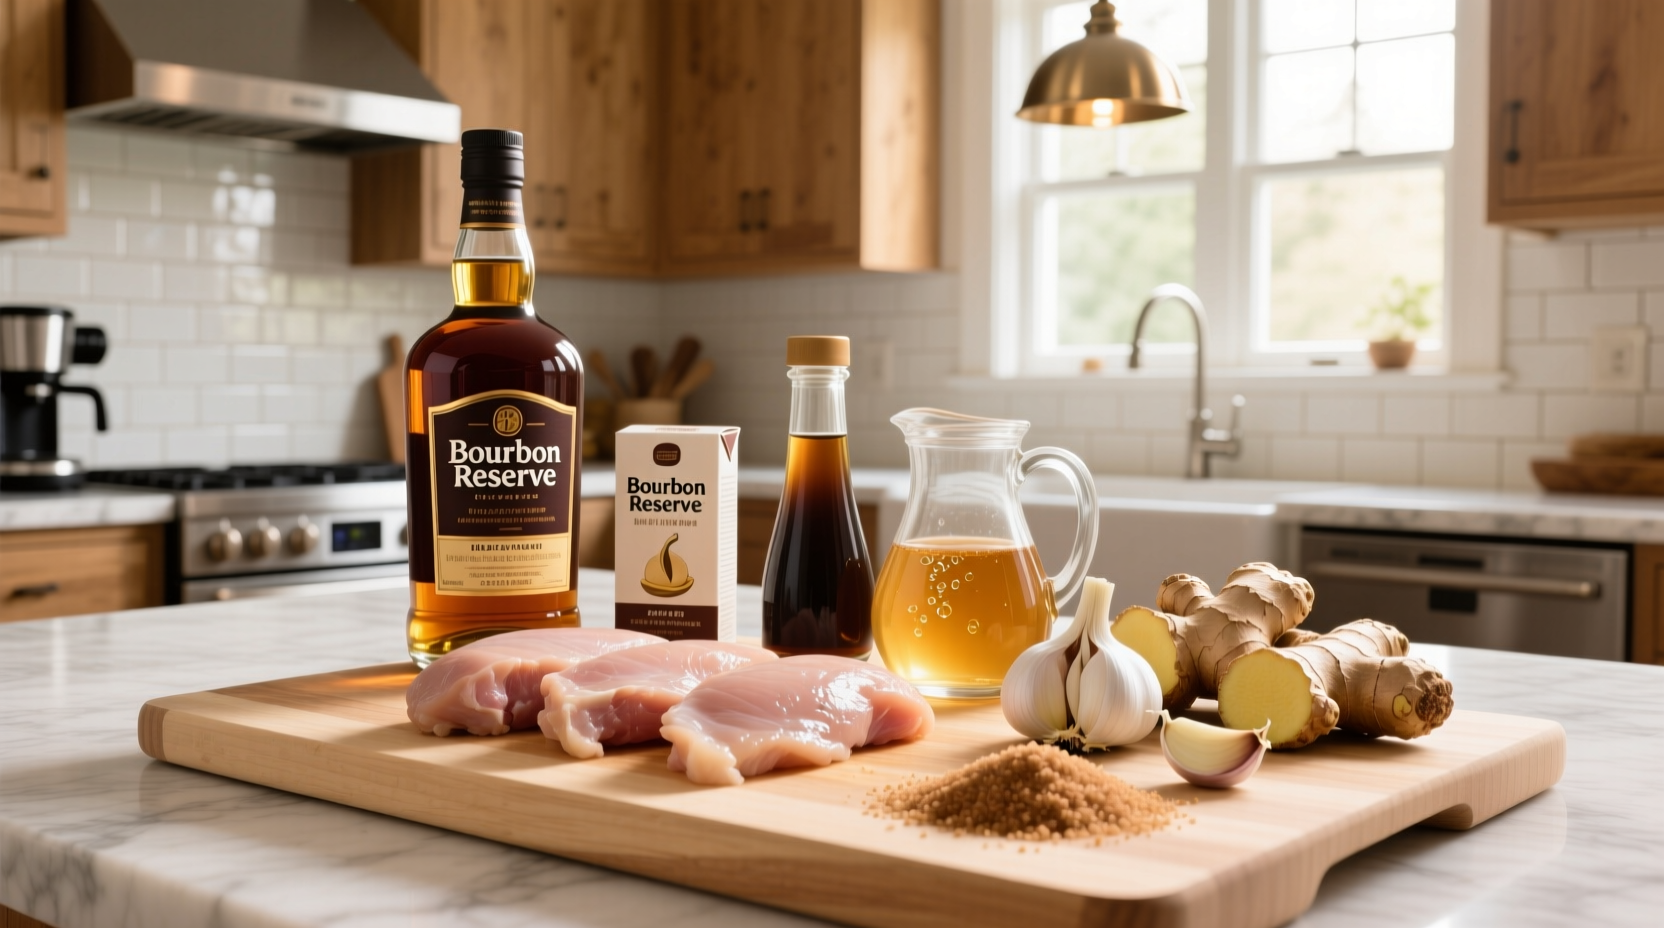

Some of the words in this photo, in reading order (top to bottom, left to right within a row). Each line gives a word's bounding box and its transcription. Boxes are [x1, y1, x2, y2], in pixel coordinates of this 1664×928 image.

[448, 438, 562, 464] Bourbon
[454, 464, 557, 488] Reserve
[627, 476, 706, 496] Bourbon
[629, 495, 703, 513] Reserve
